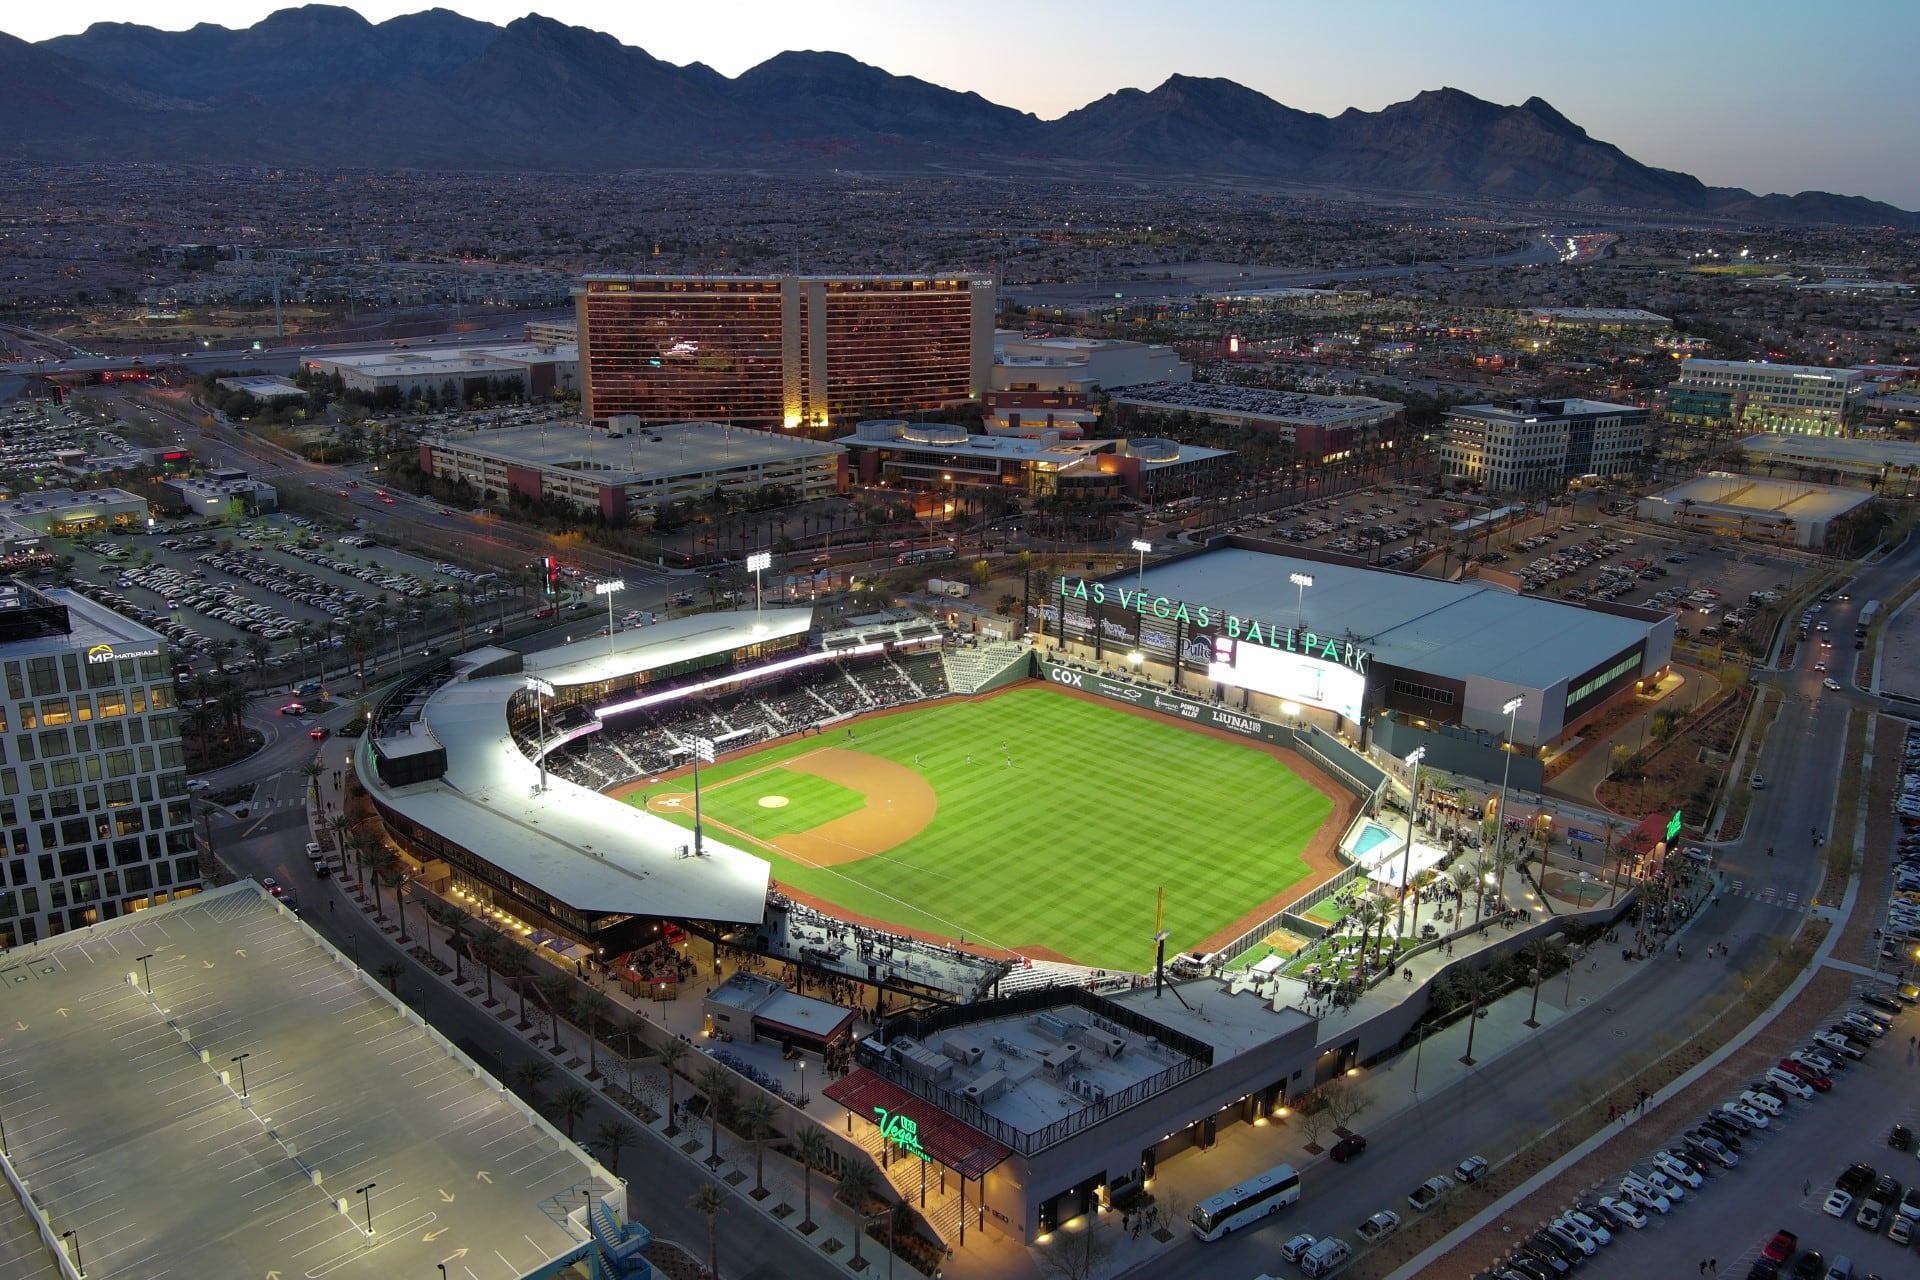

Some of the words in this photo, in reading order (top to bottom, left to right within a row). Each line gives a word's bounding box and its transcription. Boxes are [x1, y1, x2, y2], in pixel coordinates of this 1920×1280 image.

[1061, 576, 1105, 604] LAS
[1118, 587, 1209, 628] VEGAS
[1228, 615, 1366, 675] BALLPARK
[88, 652, 114, 664] MP
[114, 649, 159, 659] MATERIALS
[1181, 638, 1211, 657] Pulte
[1052, 668, 1082, 687] COX
[1180, 702, 1200, 713] POWER
[1181, 709, 1199, 719] ALLEY
[873, 1106, 924, 1149] Vegas
